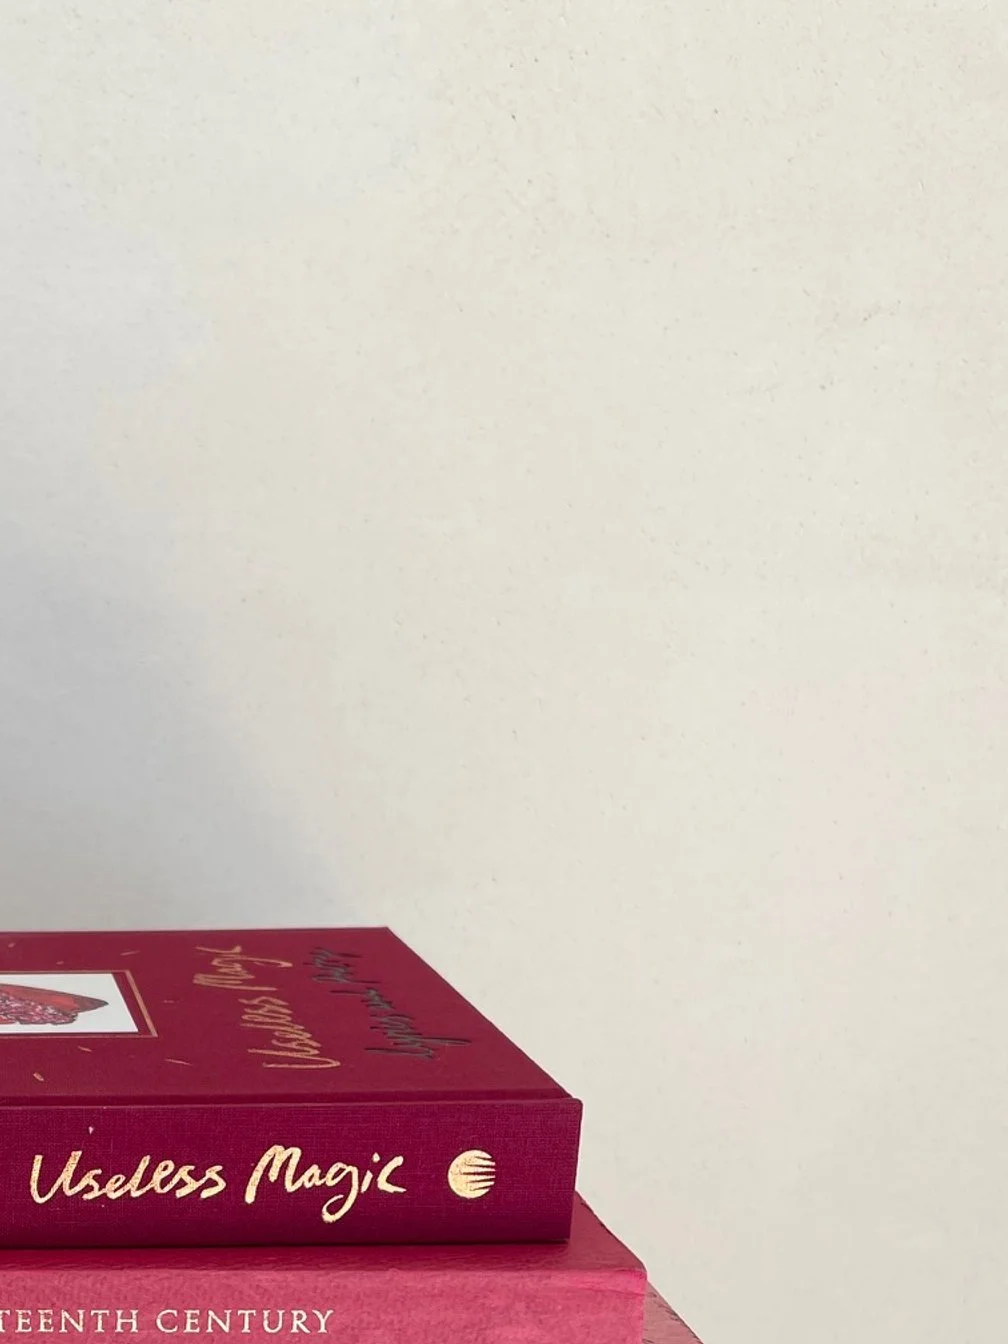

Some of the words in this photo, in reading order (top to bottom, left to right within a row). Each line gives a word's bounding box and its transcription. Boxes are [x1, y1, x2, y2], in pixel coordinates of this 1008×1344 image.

[193, 944, 293, 992] Magic
[240, 993, 341, 1070] Useless
[30, 1150, 227, 1203] Useless
[245, 1145, 407, 1223] Magic
[156, 1308, 334, 1334] CENTURY
